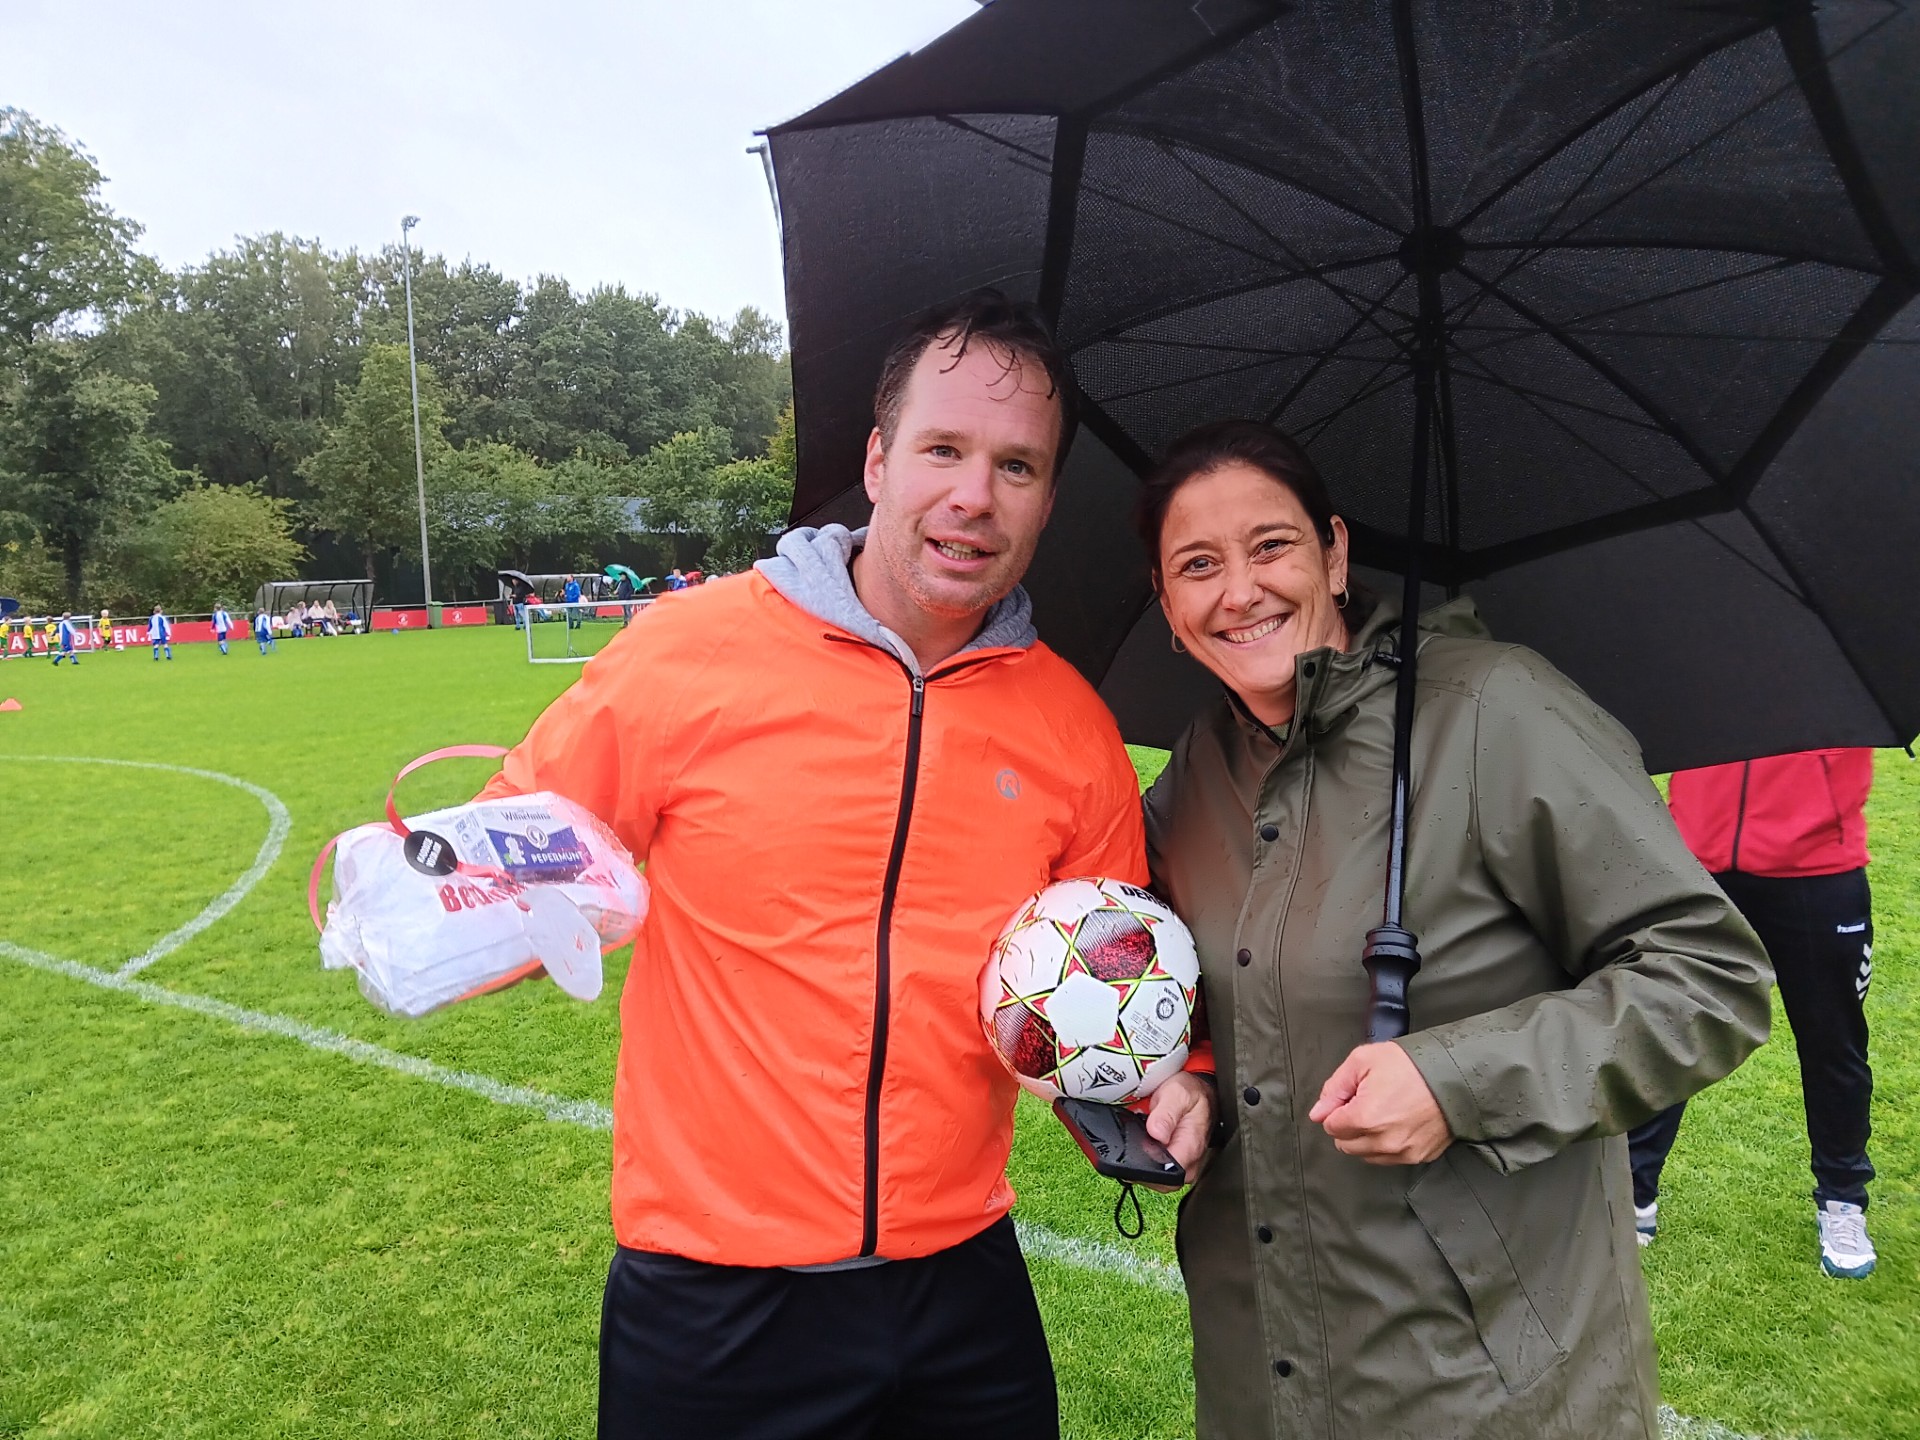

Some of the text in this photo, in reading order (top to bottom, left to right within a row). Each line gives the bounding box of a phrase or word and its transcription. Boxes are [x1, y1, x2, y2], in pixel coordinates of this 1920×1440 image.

[501, 810, 551, 821] Wilhelmina
[531, 851, 584, 864] PEPERMUNT
[1097, 1061, 1127, 1083] SELECT
